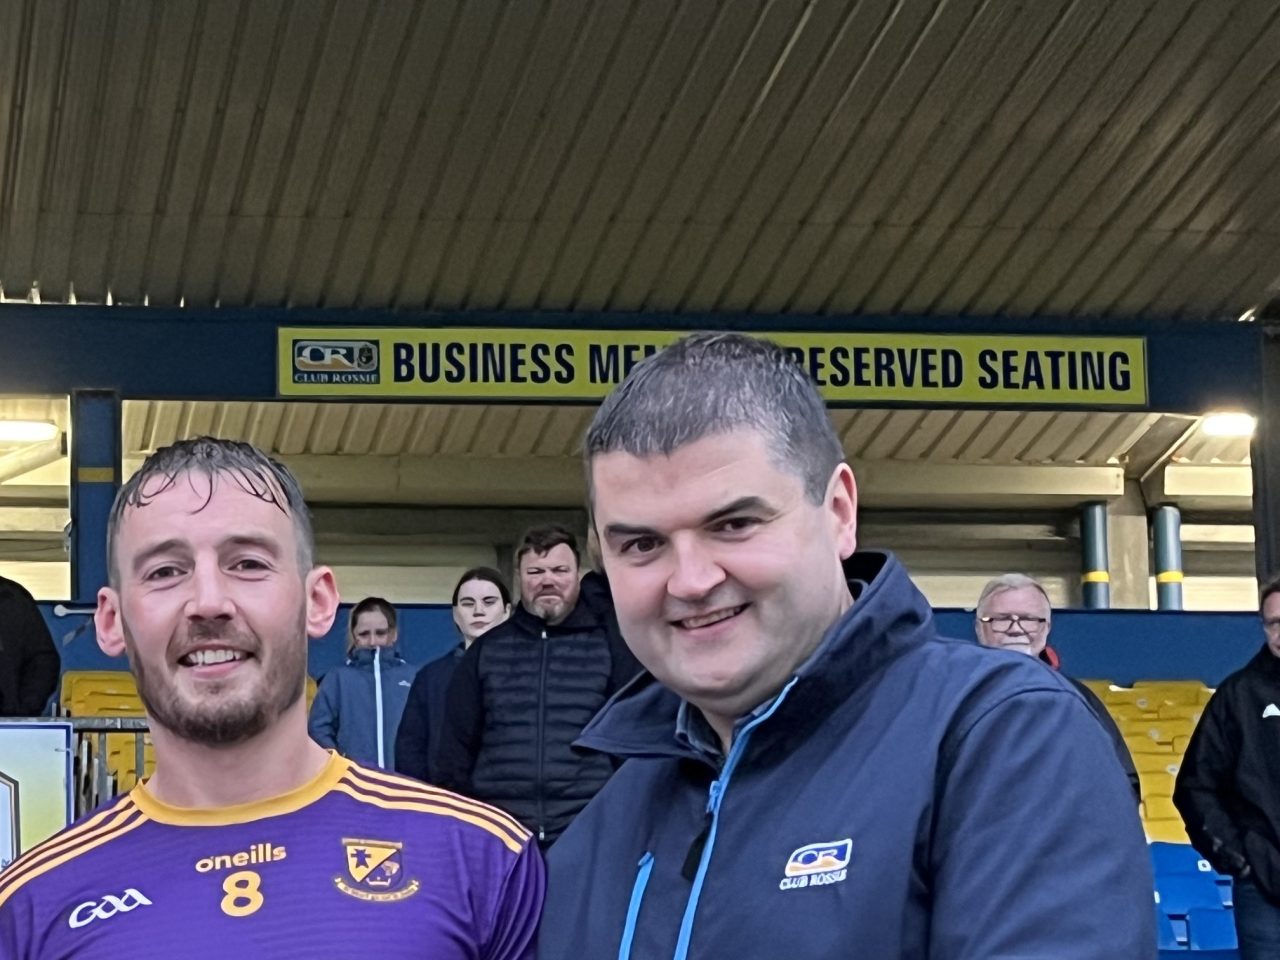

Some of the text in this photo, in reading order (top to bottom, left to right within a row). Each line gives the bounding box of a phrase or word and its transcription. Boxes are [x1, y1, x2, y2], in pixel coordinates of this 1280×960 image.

[393, 342, 575, 384] BUSINESS
[978, 349, 1131, 391] SEATING
[220, 870, 264, 917] 8
